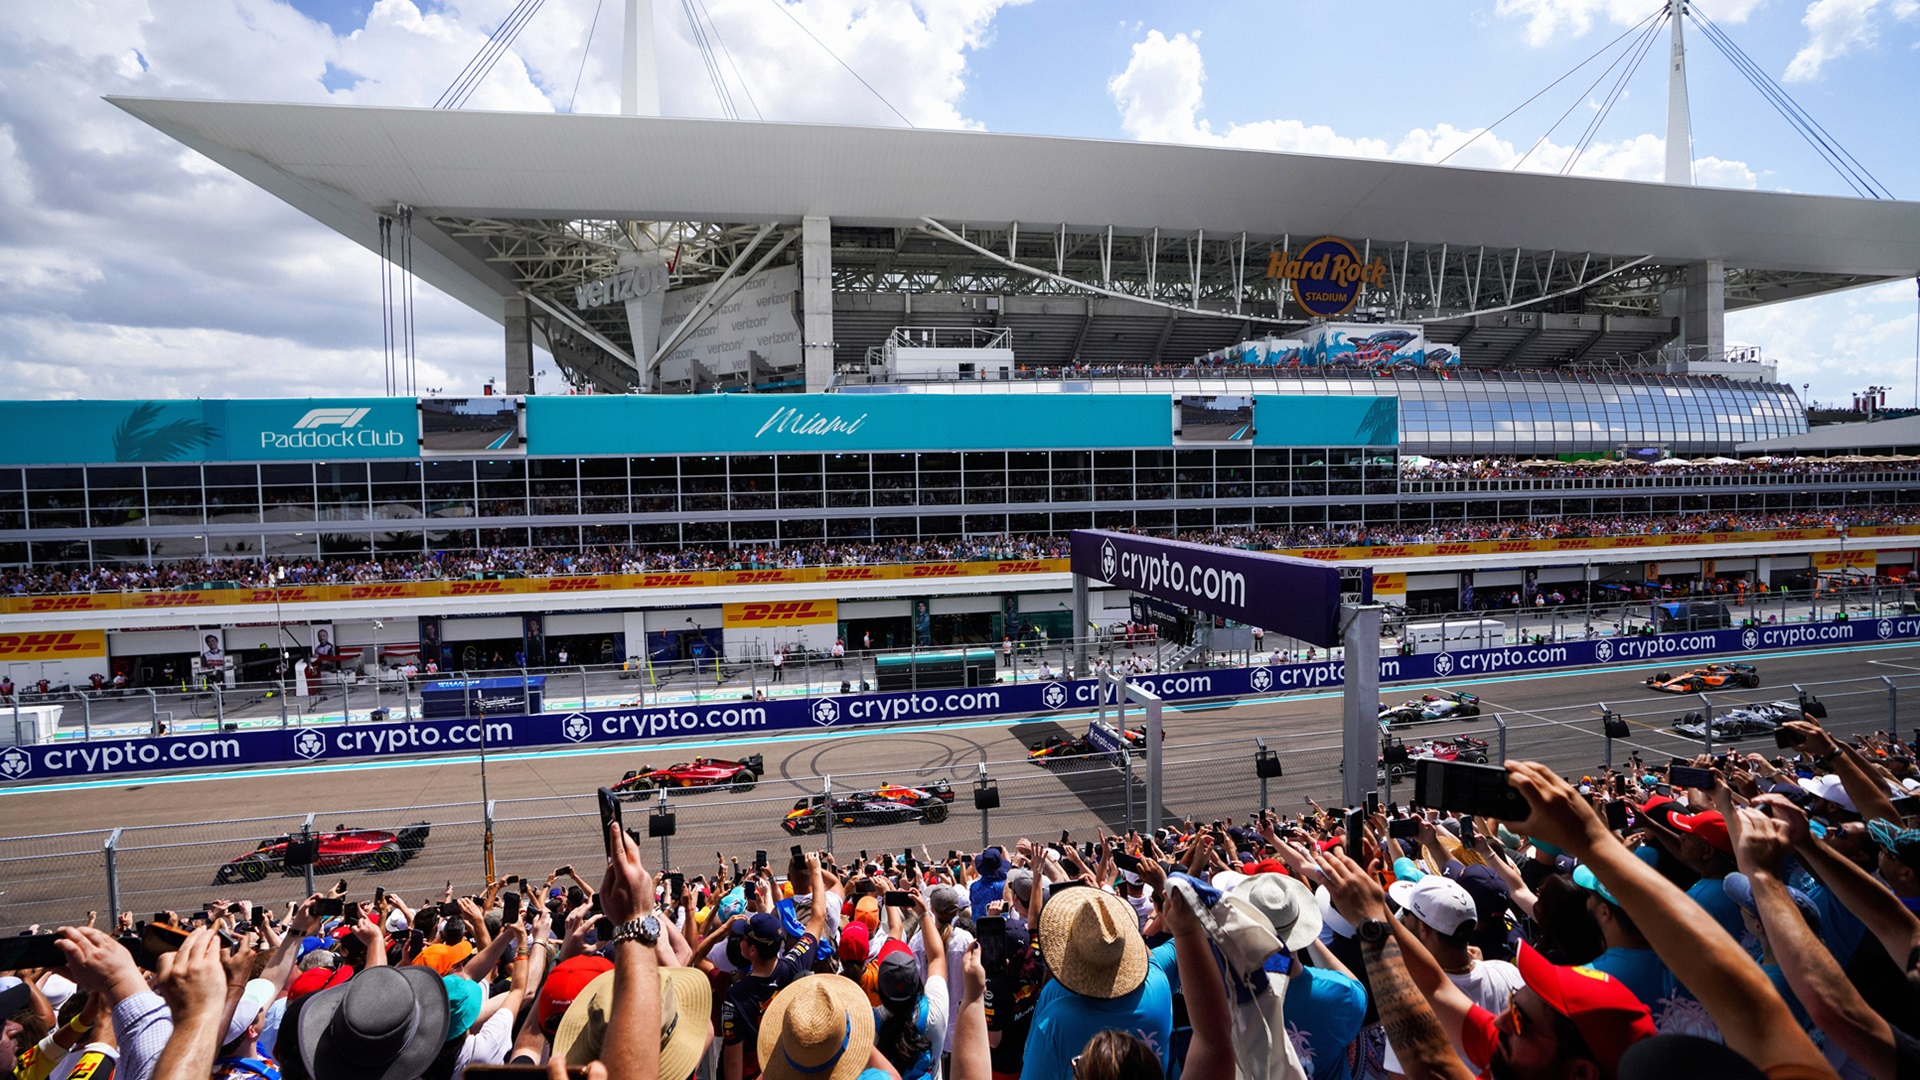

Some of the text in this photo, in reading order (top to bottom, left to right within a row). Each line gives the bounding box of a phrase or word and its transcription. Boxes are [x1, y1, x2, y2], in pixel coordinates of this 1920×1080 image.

[1267, 251, 1387, 289] Hard Rock
[574, 263, 670, 311] verizon
[1304, 291, 1348, 303] STADIUM
[731, 317, 767, 332] verizon
[757, 332, 794, 347] verizon
[707, 340, 741, 355] verizon
[755, 406, 868, 438] Miami
[261, 430, 404, 448] Paddock Club
[1776, 531, 1804, 540] DHL
[1875, 526, 1902, 536] DHL
[1558, 539, 1590, 549] DHL
[1615, 536, 1647, 547] DHL
[1670, 534, 1701, 544] DHL
[1371, 547, 1408, 557] DHL
[1436, 544, 1471, 554] DHL
[1497, 541, 1532, 552] DHL
[1302, 549, 1340, 560] DHL
[1824, 551, 1866, 565] DHL
[913, 565, 961, 576] DHL
[997, 561, 1043, 573] DHL
[643, 574, 694, 587] DHL
[736, 571, 786, 583] DHL
[825, 568, 875, 580] DHL
[1121, 551, 1246, 608] crypto.com
[450, 581, 505, 594] DHL
[549, 578, 601, 590] DHL
[251, 588, 309, 602] DHL
[351, 585, 407, 598] DHL
[29, 597, 94, 611] DHL
[144, 593, 203, 606] DHL
[742, 602, 820, 621] DHL
[1763, 624, 1854, 646] crypto.com
[1619, 634, 1716, 658] crypto.com
[1460, 646, 1567, 671] crypto.com
[849, 691, 1000, 720] crypto.com
[601, 706, 767, 737] crypto.com
[336, 722, 513, 753] crypto.com
[43, 738, 241, 772] crypto.com
